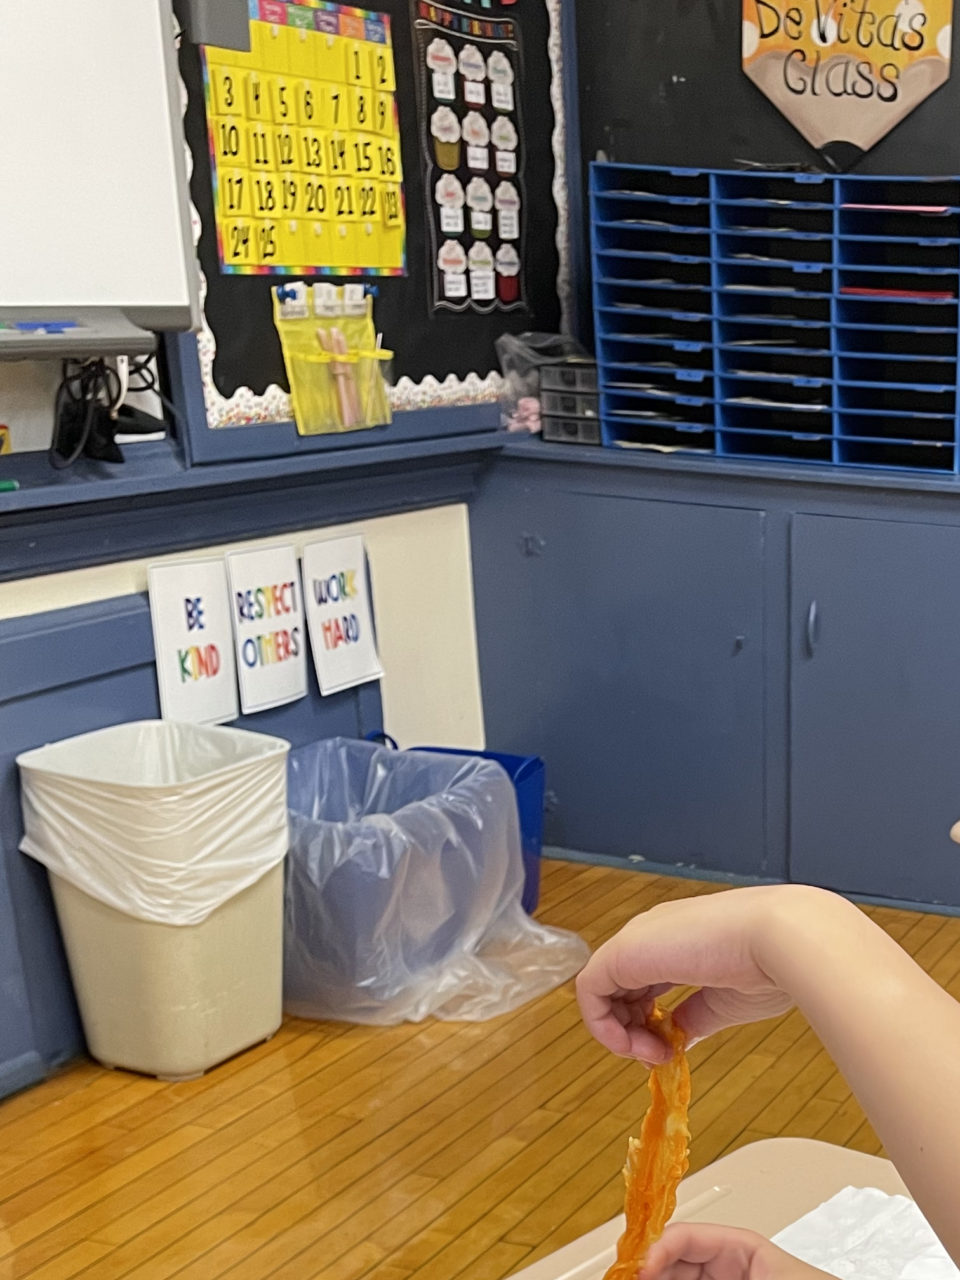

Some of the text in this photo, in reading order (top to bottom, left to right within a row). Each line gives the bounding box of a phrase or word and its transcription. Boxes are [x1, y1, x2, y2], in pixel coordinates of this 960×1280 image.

[353, 51, 387, 84] 1 2
[783, 49, 899, 102] Class
[223, 76, 234, 107] 3
[279, 86, 288, 117] 5
[304, 90, 314, 120] 6
[331, 93, 340, 124] 7
[357, 95, 367, 124] 8
[377, 101, 386, 130] 9
[221, 123, 396, 175] 10 11 12 13 14 15 16
[228, 178, 243, 210] 17
[256, 180, 275, 211] 18
[282, 179, 297, 211] 19
[305, 182, 326, 212] 20
[335, 186, 354, 216] 21
[360, 186, 376, 216] 22
[231, 225, 277, 259] 24 25
[236, 581, 298, 623] RESPECT
[312, 569, 359, 607] WORK
[184, 597, 205, 632] BE
[320, 614, 360, 650] HARD
[177, 644, 221, 683] KIND
[242, 627, 300, 668] OTHERS
